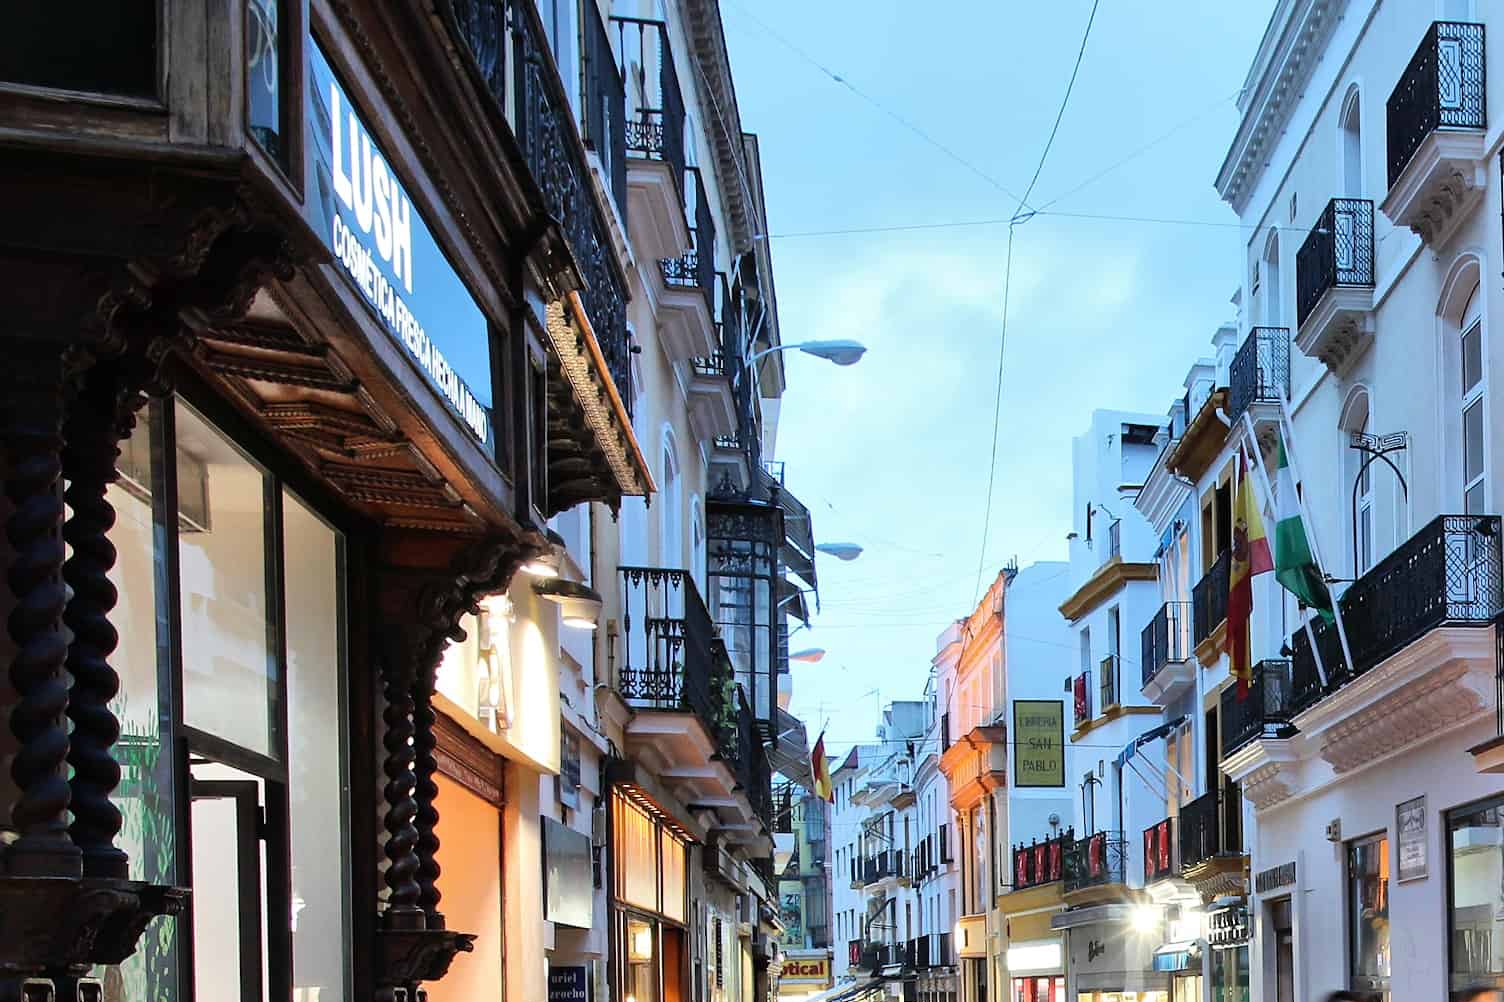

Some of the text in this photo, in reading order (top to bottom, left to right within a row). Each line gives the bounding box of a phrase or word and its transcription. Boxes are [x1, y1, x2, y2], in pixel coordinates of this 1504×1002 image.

[331, 82, 412, 295] LUSH
[333, 214, 395, 326] COSMÉTICA
[396, 295, 431, 375] FRESCA
[1029, 736, 1052, 750] SAN
[1022, 760, 1057, 772] PABLO
[781, 961, 824, 978] ptical
[551, 971, 577, 984] uriel
